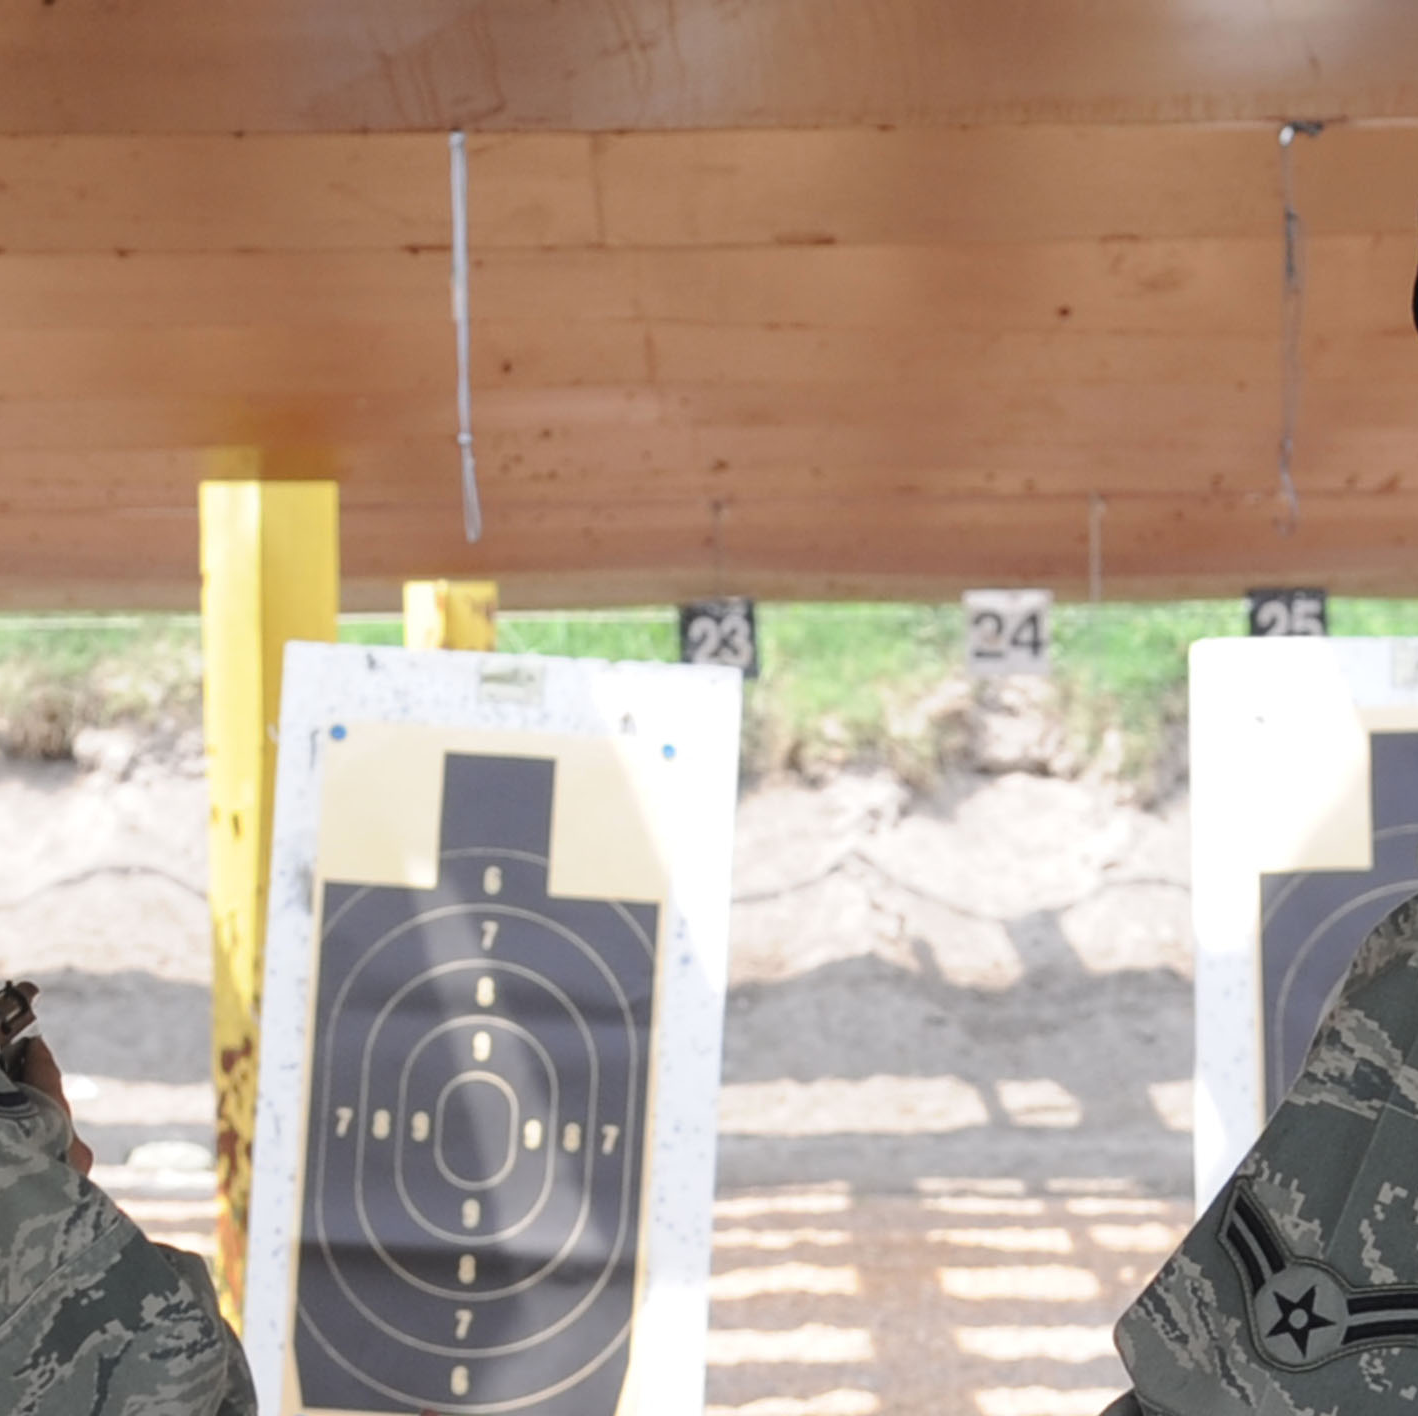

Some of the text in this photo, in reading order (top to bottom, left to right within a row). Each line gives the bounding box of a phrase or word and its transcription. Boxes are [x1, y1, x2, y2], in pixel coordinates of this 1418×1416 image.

[688, 614, 751, 668] 23
[973, 610, 1042, 659] 24
[483, 865, 502, 895] 6
[481, 920, 499, 950] 7
[335, 1106, 620, 1155] 7 8 9 9 8 7
[462, 1198, 481, 1229] 9
[458, 1253, 477, 1285] 8
[454, 1309, 473, 1340] 7
[450, 1364, 469, 1396] 6
